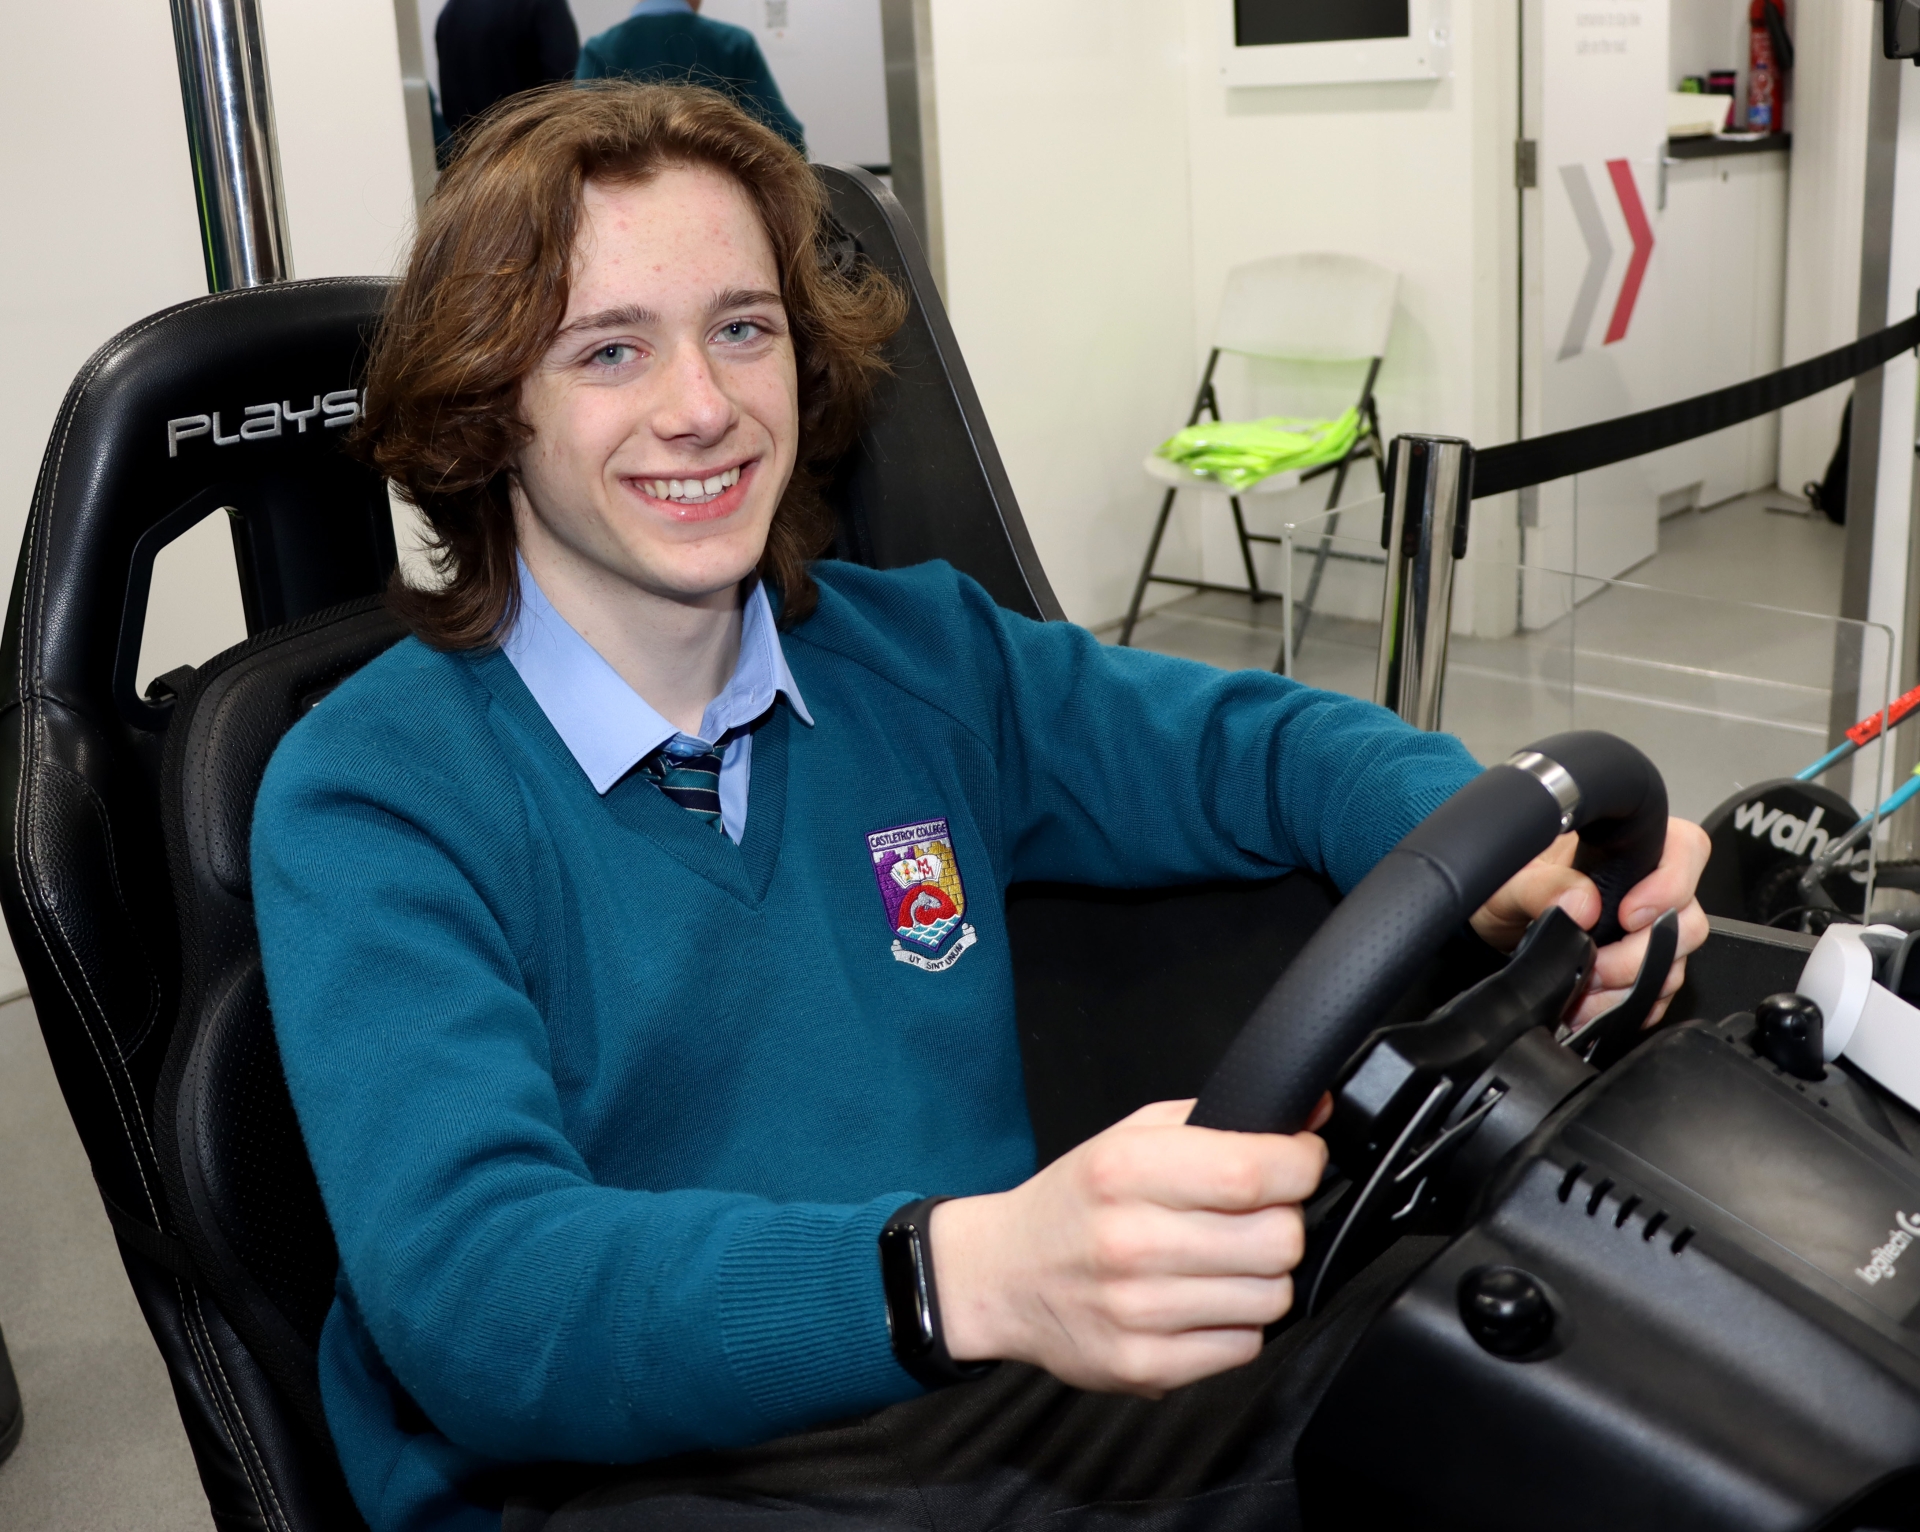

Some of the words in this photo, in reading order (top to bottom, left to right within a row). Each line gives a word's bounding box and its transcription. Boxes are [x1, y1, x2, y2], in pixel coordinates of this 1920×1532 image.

[870, 829, 915, 848] CASTLETROY
[916, 823, 947, 838] COLLEGE
[909, 954, 922, 964] UT
[926, 961, 945, 970] SINT
[944, 943, 964, 965] UNUM
[1855, 1229, 1914, 1286] logitech
